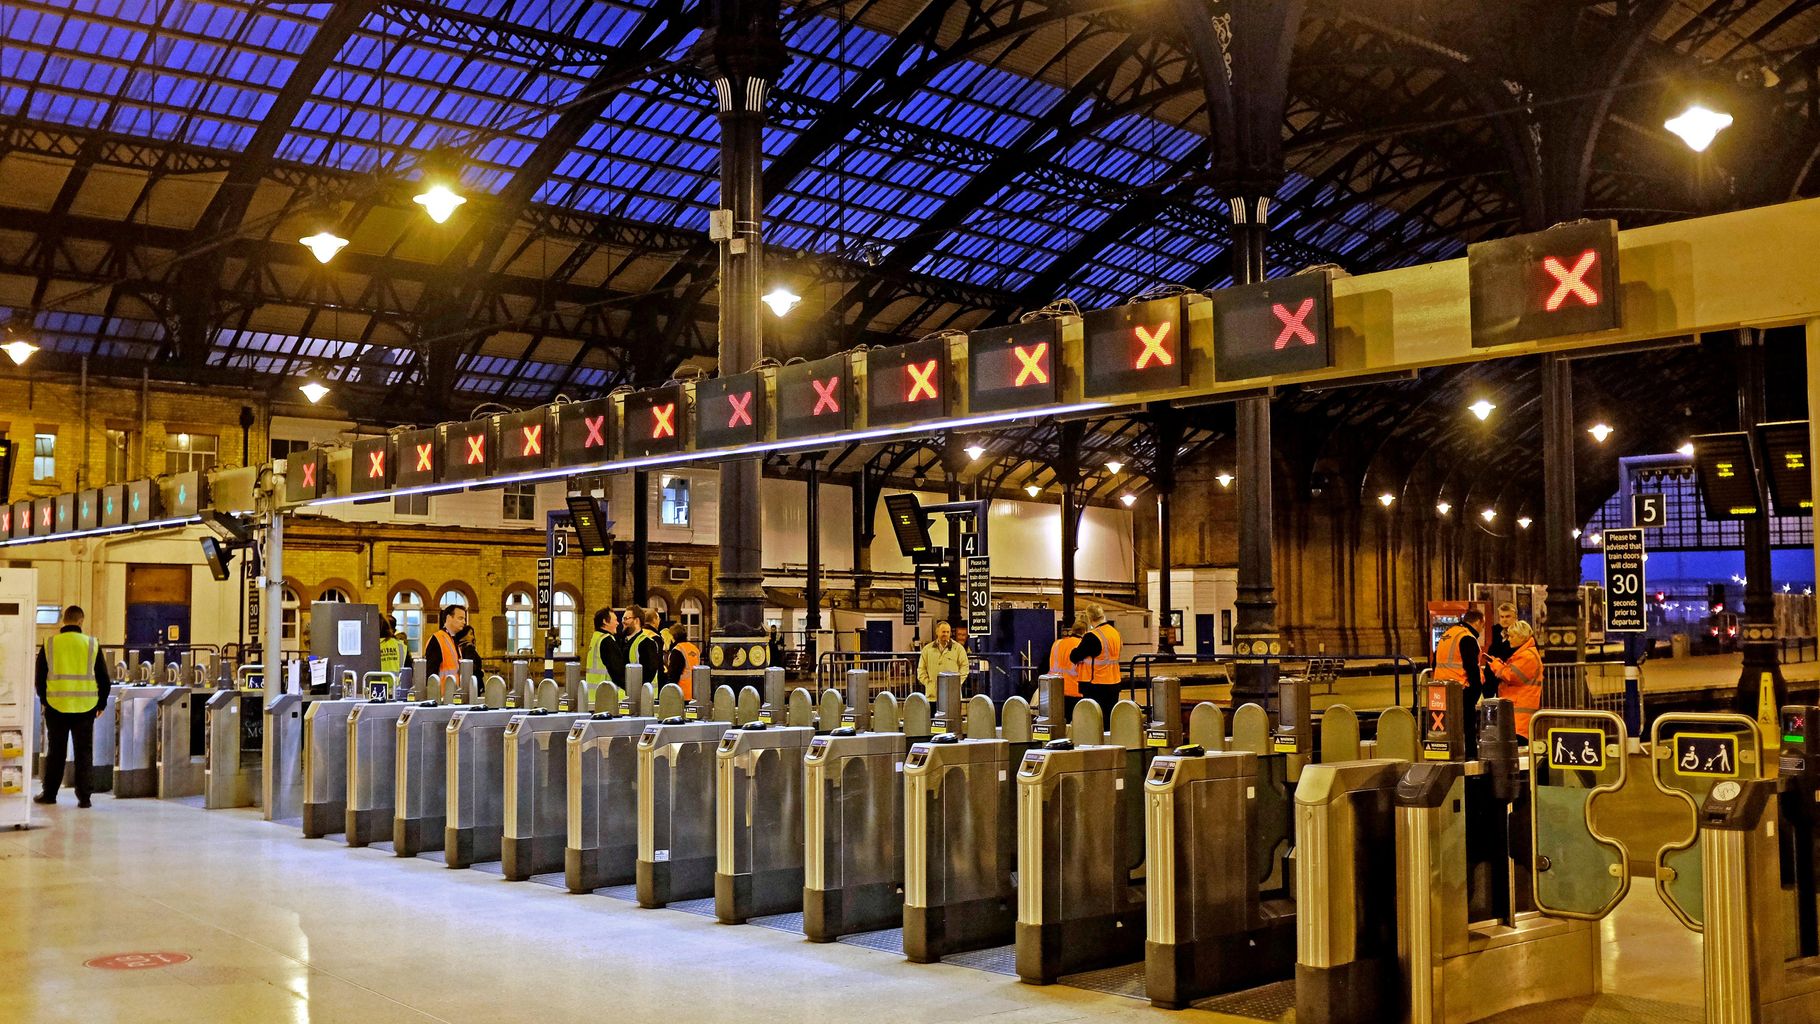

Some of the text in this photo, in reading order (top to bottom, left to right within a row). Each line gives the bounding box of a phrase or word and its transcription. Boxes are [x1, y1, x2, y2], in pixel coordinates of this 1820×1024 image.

[1643, 499, 1656, 522] 5
[557, 537, 563, 553] 3
[966, 536, 974, 554] 4
[248, 564, 252, 576] 2
[923, 580, 926, 589] 1
[1612, 574, 1638, 594] 30
[540, 590, 549, 604] 30
[972, 591, 987, 606] 30
[250, 604, 258, 616] 30
[906, 604, 915, 612] 30
[1612, 619, 1640, 627] departure
[1431, 700, 1444, 709] Entry
